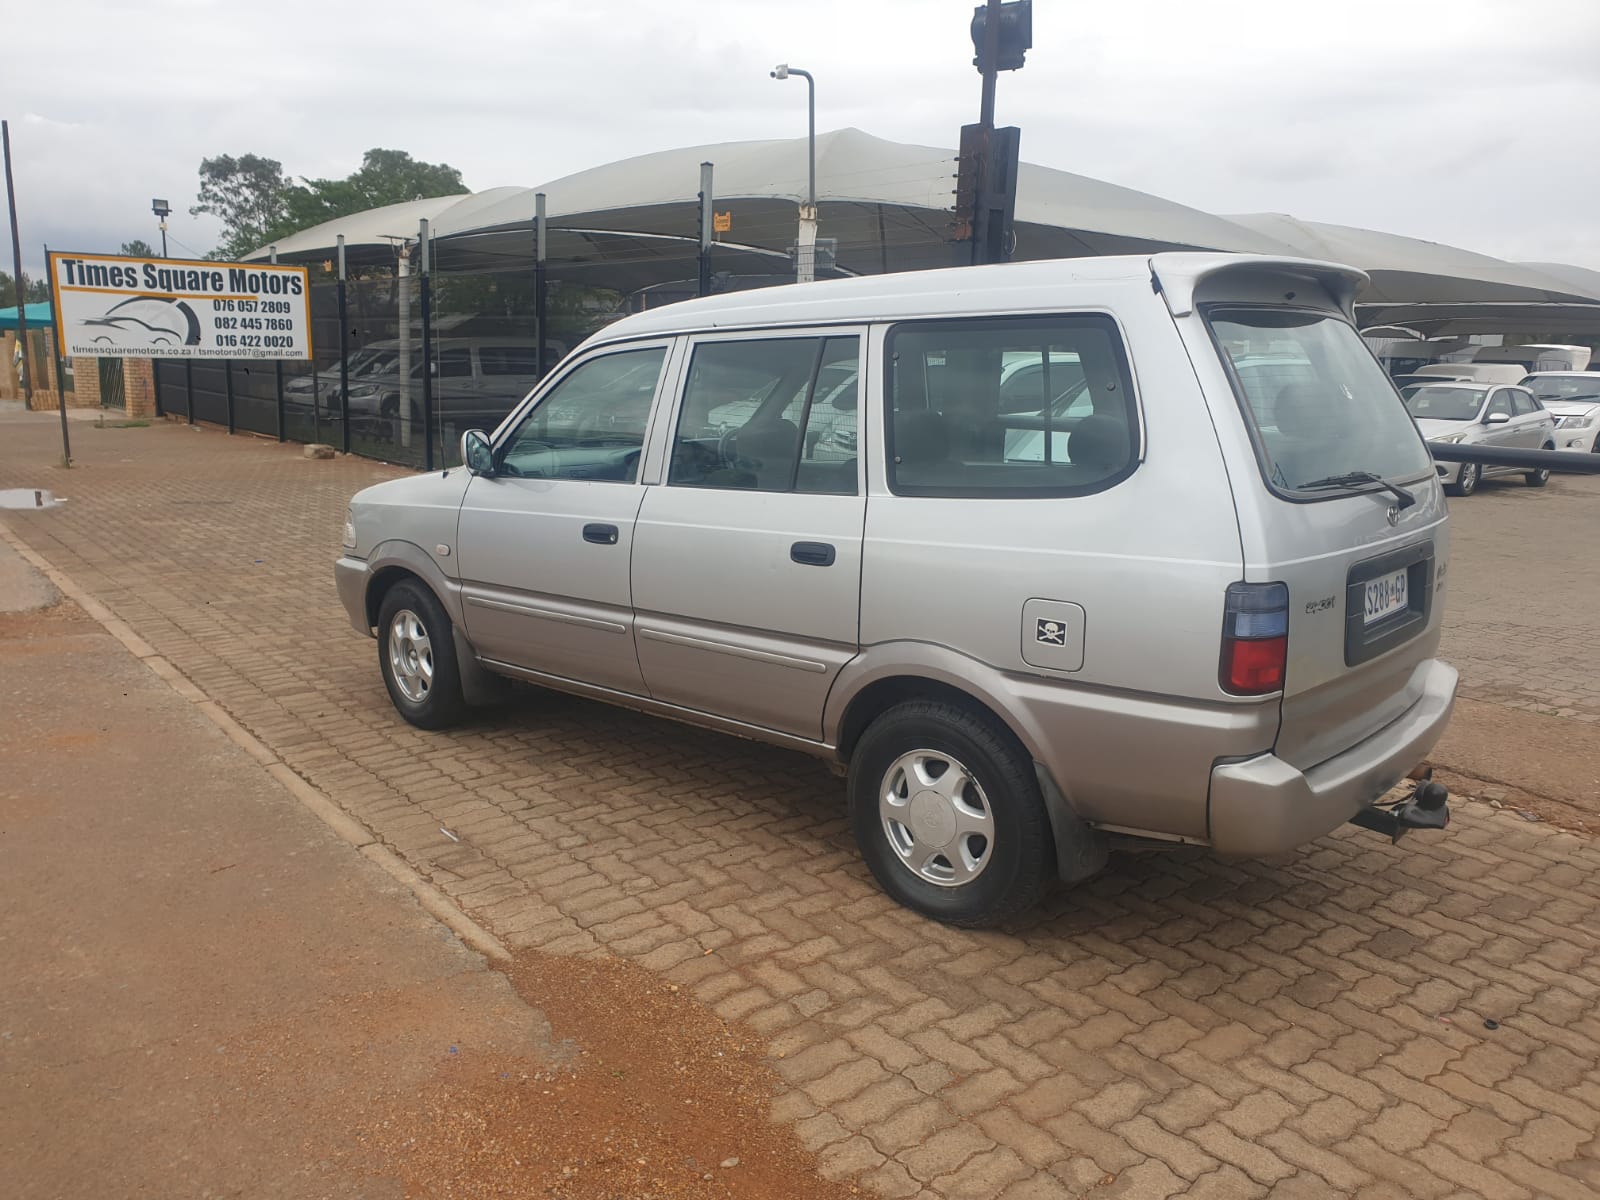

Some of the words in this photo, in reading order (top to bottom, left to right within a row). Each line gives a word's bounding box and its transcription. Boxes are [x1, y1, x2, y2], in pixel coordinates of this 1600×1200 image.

[62, 259, 138, 288] Times
[142, 263, 224, 292] Square
[229, 268, 302, 295] Motors
[213, 299, 235, 312] 076
[237, 300, 258, 313] 057
[261, 301, 291, 314] 2809
[214, 317, 237, 329] 082
[240, 318, 262, 330] 445
[264, 318, 293, 331] 7860
[216, 335, 237, 347] 016
[240, 335, 261, 347] 422
[264, 335, 294, 348] 0020
[72, 345, 191, 355] timessquaremotors.co.za
[198, 348, 303, 357] tsmotors007@gmail.com
